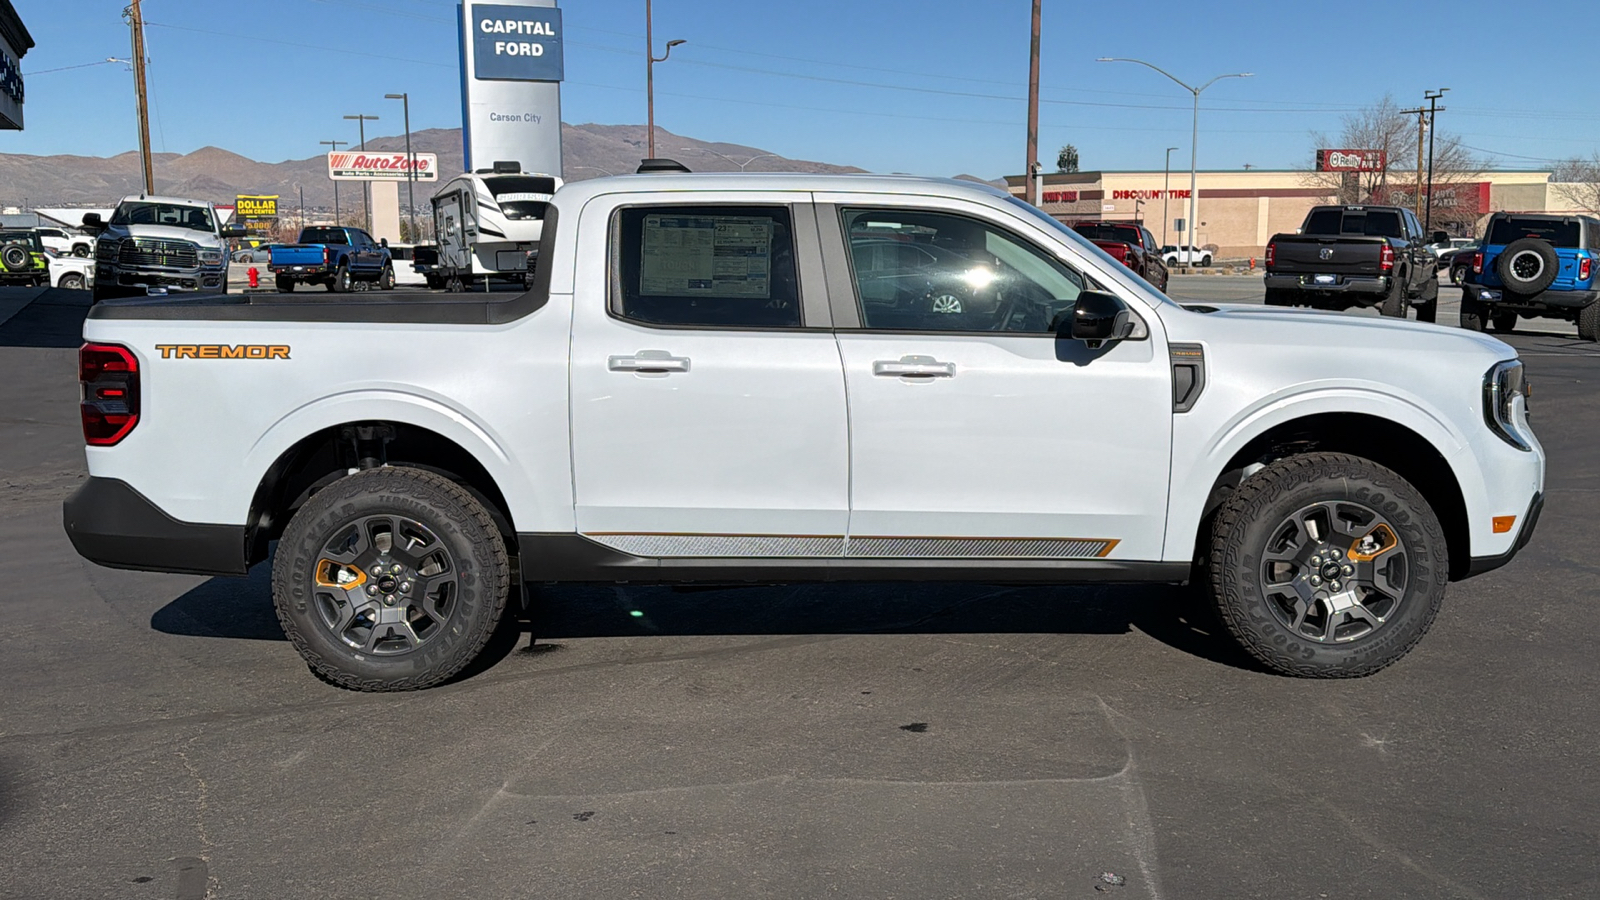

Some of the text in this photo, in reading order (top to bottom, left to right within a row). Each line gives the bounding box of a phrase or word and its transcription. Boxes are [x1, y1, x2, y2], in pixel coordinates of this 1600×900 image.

[480, 19, 555, 36] CAPITAL
[495, 41, 544, 56] FORD
[489, 112, 542, 124] Carson City
[352, 154, 429, 170] AutoZone
[1330, 151, 1361, 169] O'Reilly
[1112, 189, 1192, 199] DISCOUNT TIRE
[237, 200, 276, 209] DOLLAR
[155, 344, 292, 359] TREMOR
[378, 495, 441, 524] TERRITORY
[1355, 486, 1431, 594] GOODYEAR
[291, 502, 356, 615] GOODYEAR
[411, 559, 477, 669] GOODYEAR
[1242, 554, 1316, 659] GOODYEAR
